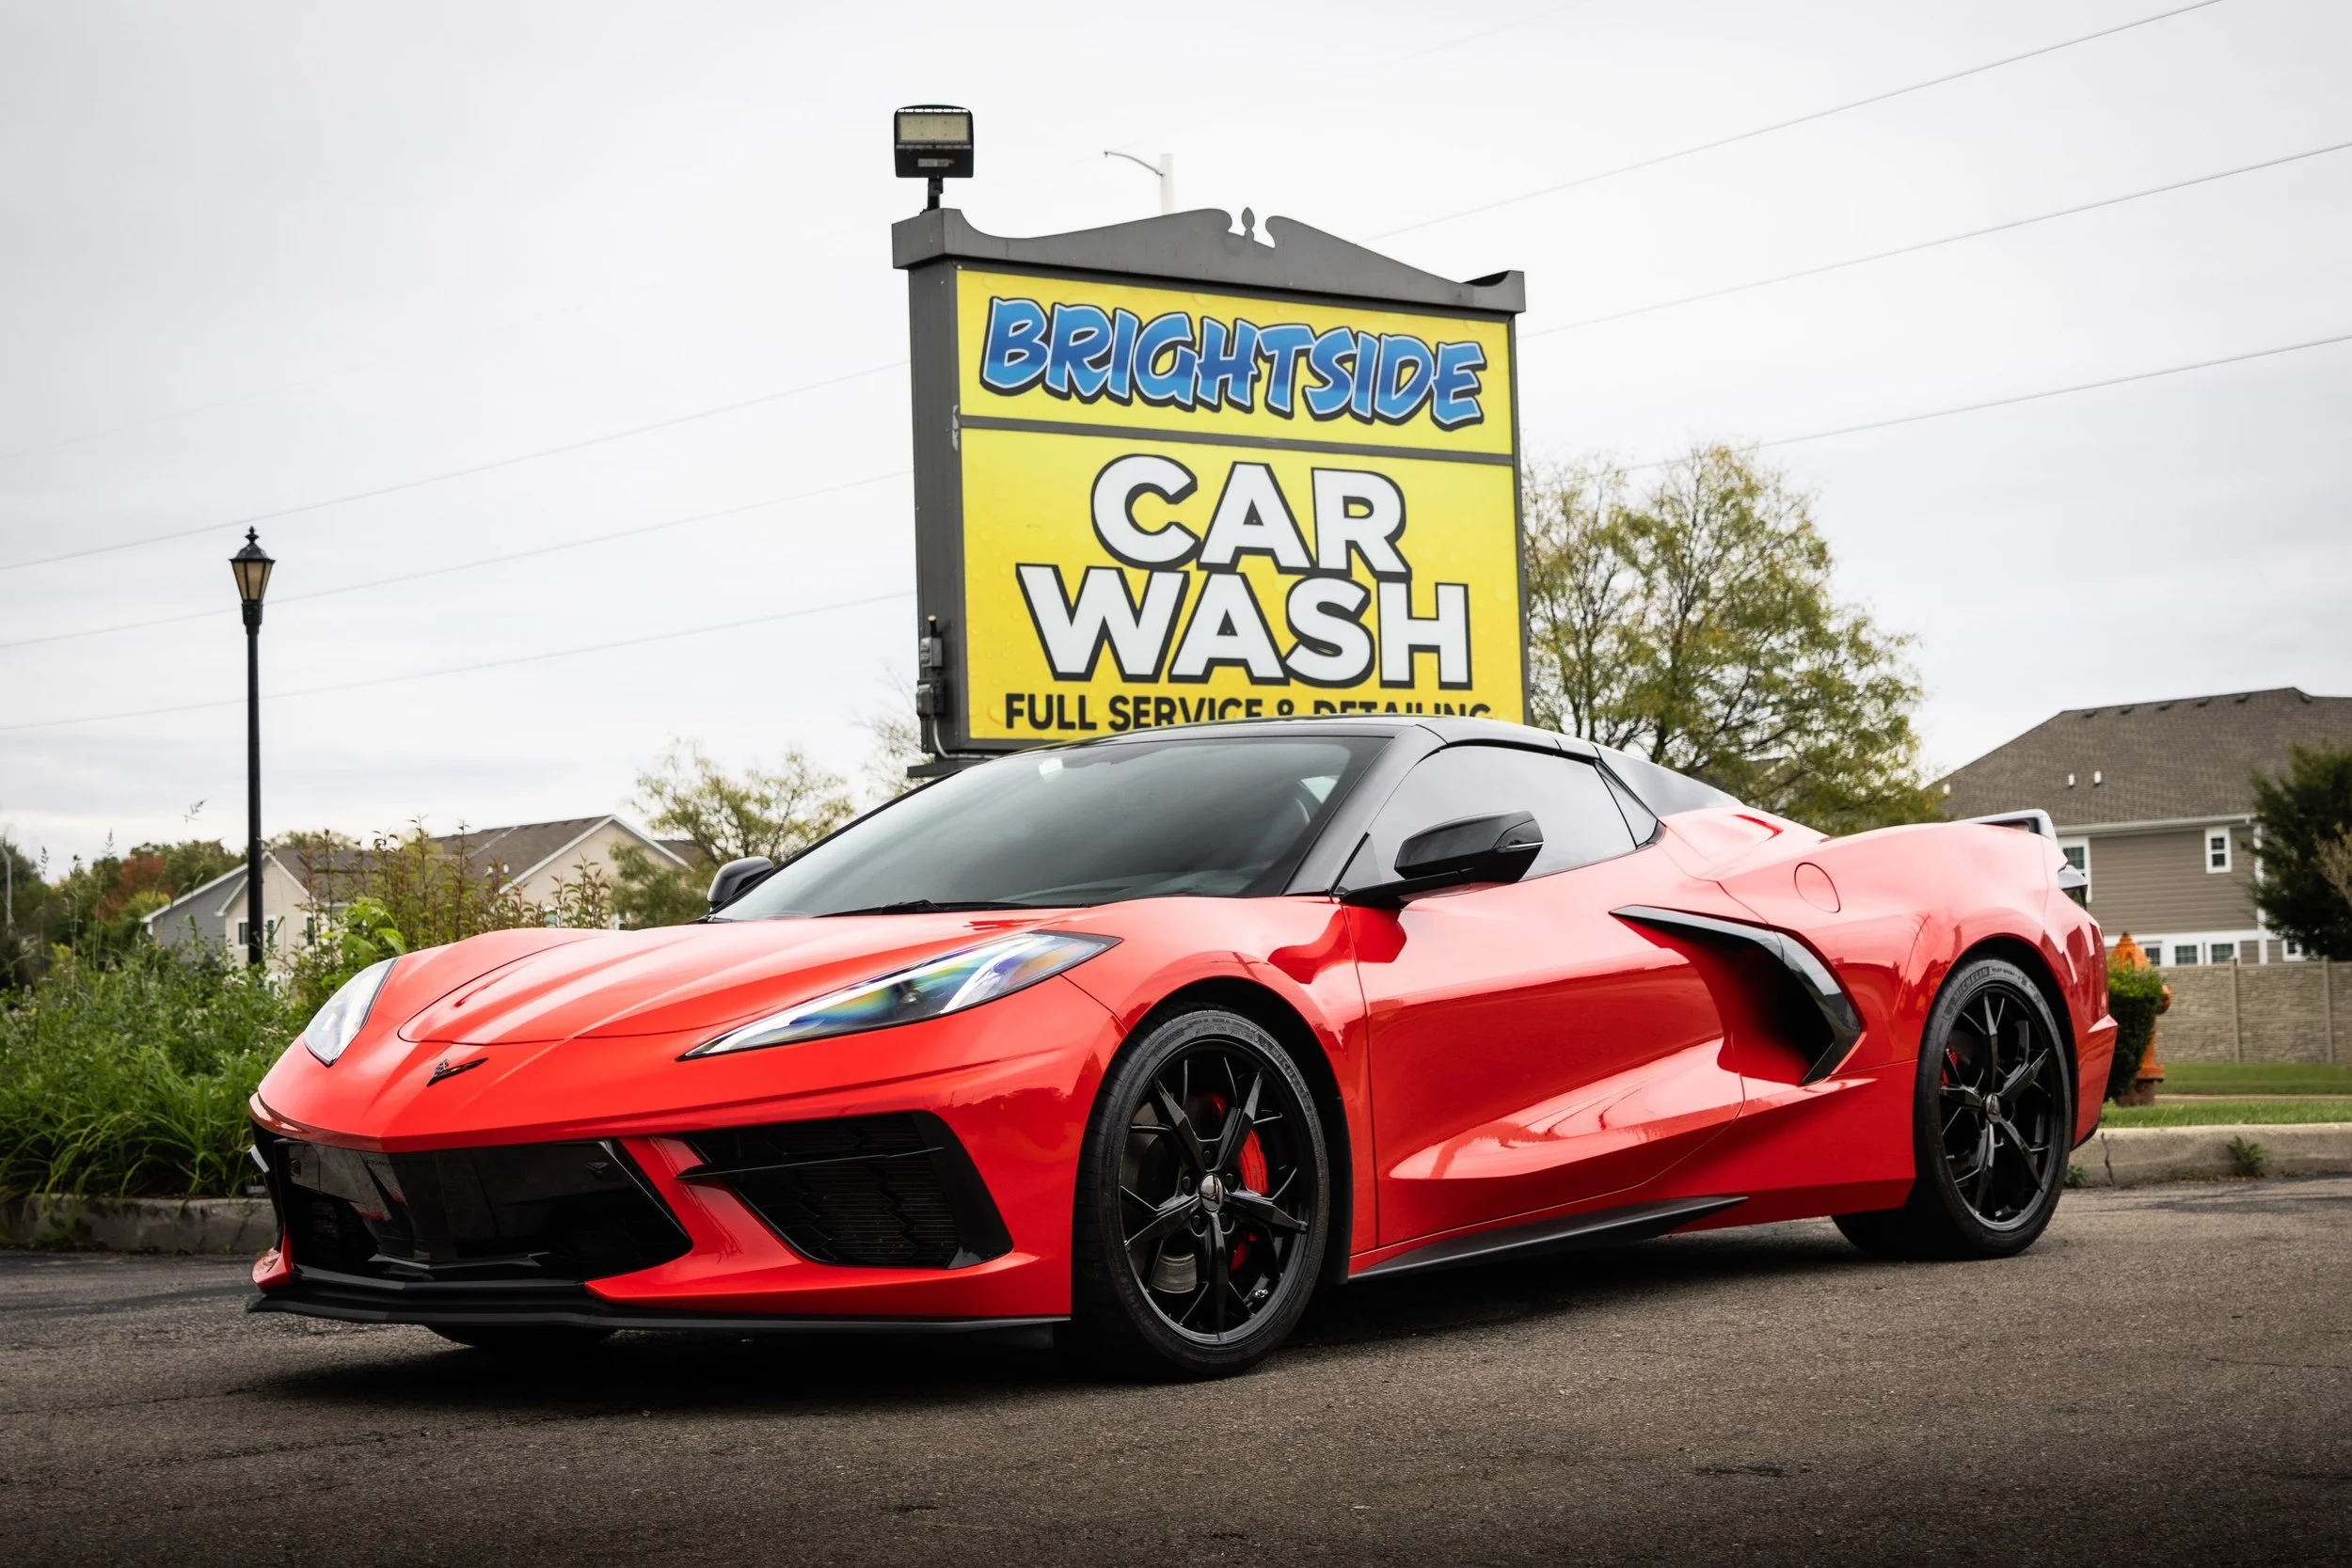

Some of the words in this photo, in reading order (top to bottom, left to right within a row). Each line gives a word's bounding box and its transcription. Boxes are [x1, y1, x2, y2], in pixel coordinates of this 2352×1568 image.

[979, 296, 1486, 432] BRIGHTSIDE
[1090, 453, 1412, 580] CAR
[1015, 562, 1473, 690] WASH
[1005, 693, 1098, 731] FULL
[1108, 694, 1263, 733] SERVICE
[1952, 966, 1990, 999] MICHELIN
